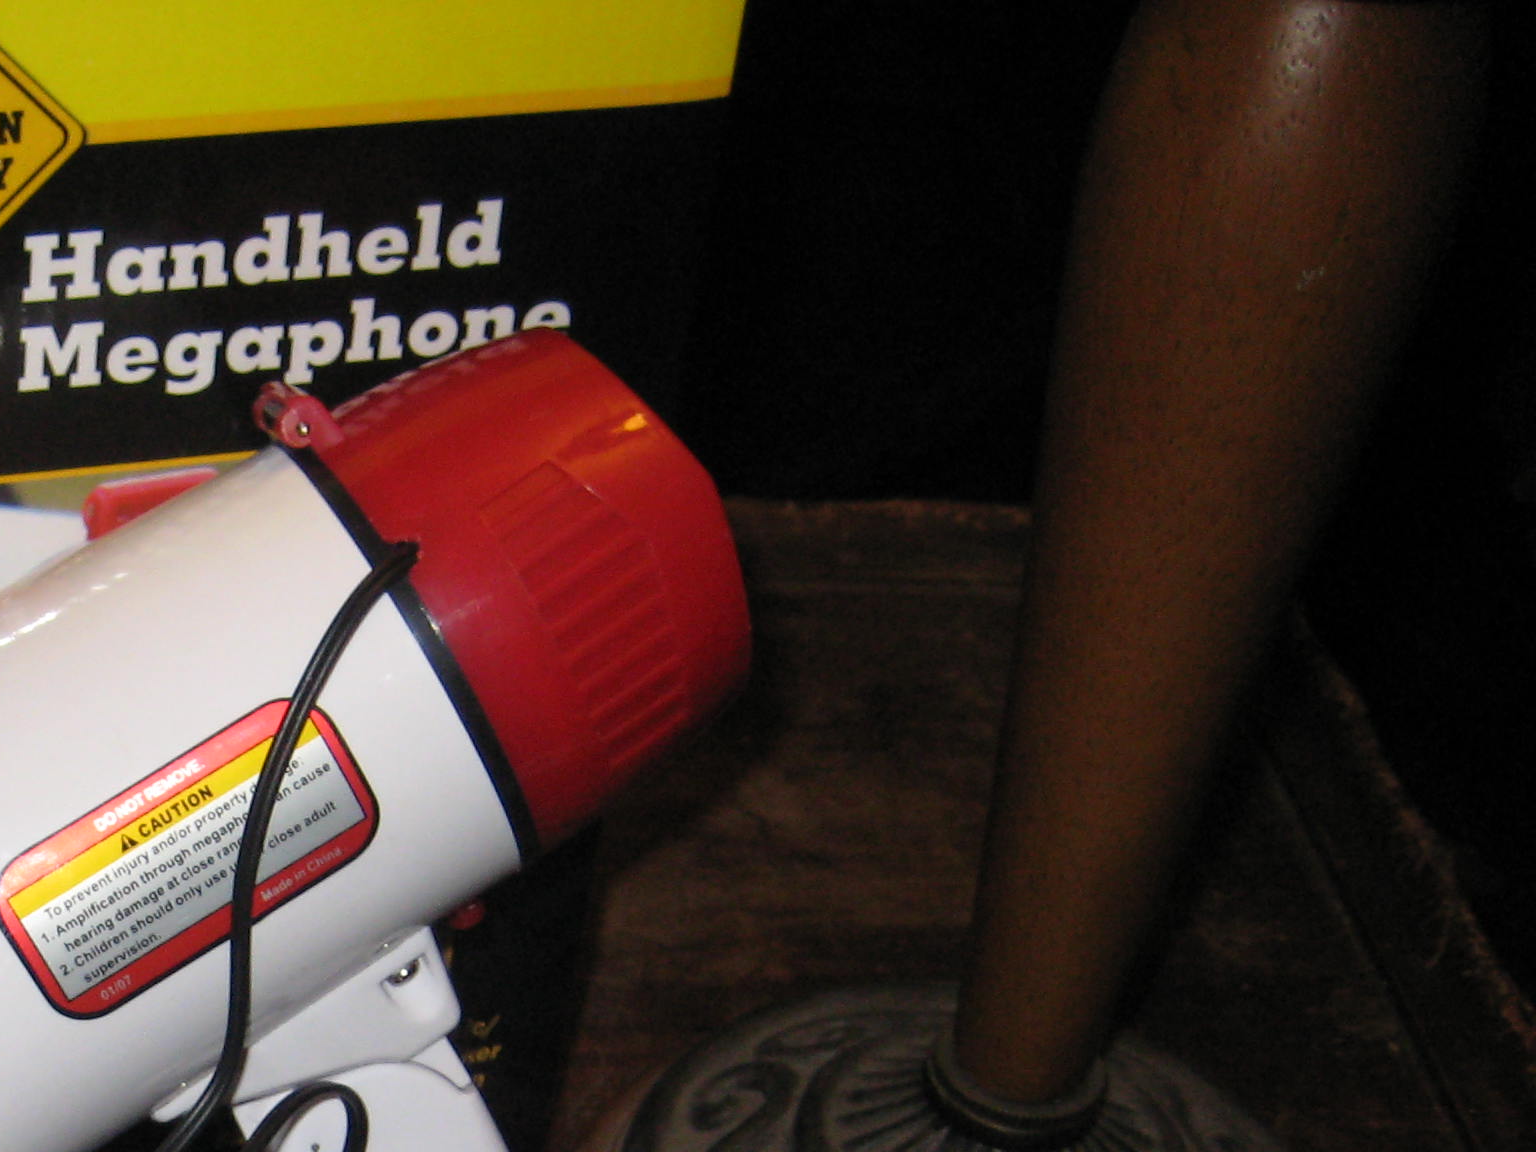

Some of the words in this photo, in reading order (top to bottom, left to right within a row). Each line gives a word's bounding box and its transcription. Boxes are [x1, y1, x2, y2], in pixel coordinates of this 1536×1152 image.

[21, 199, 504, 303] Handheld
[18, 299, 572, 395] Megaphone
[44, 905, 62, 920] To
[63, 875, 112, 911] prevent
[114, 851, 150, 880] injury
[152, 825, 192, 855] and/or
[195, 791, 248, 832] property
[56, 878, 140, 937] Amplification
[140, 847, 191, 885] through
[292, 762, 331, 791] cause
[93, 811, 118, 832] DO
[115, 793, 145, 820] NOT
[138, 785, 213, 838] CAUTION
[64, 917, 114, 953] hearing
[115, 889, 165, 924] damage
[167, 876, 181, 891] at
[181, 857, 215, 882] close
[74, 929, 131, 968] Children
[130, 903, 174, 937] should
[175, 884, 204, 906] only
[205, 870, 228, 889] use
[266, 823, 303, 849] close
[305, 800, 338, 828] adult
[260, 879, 294, 902] Made
[294, 868, 306, 882] in
[82, 932, 163, 983] supervision.
